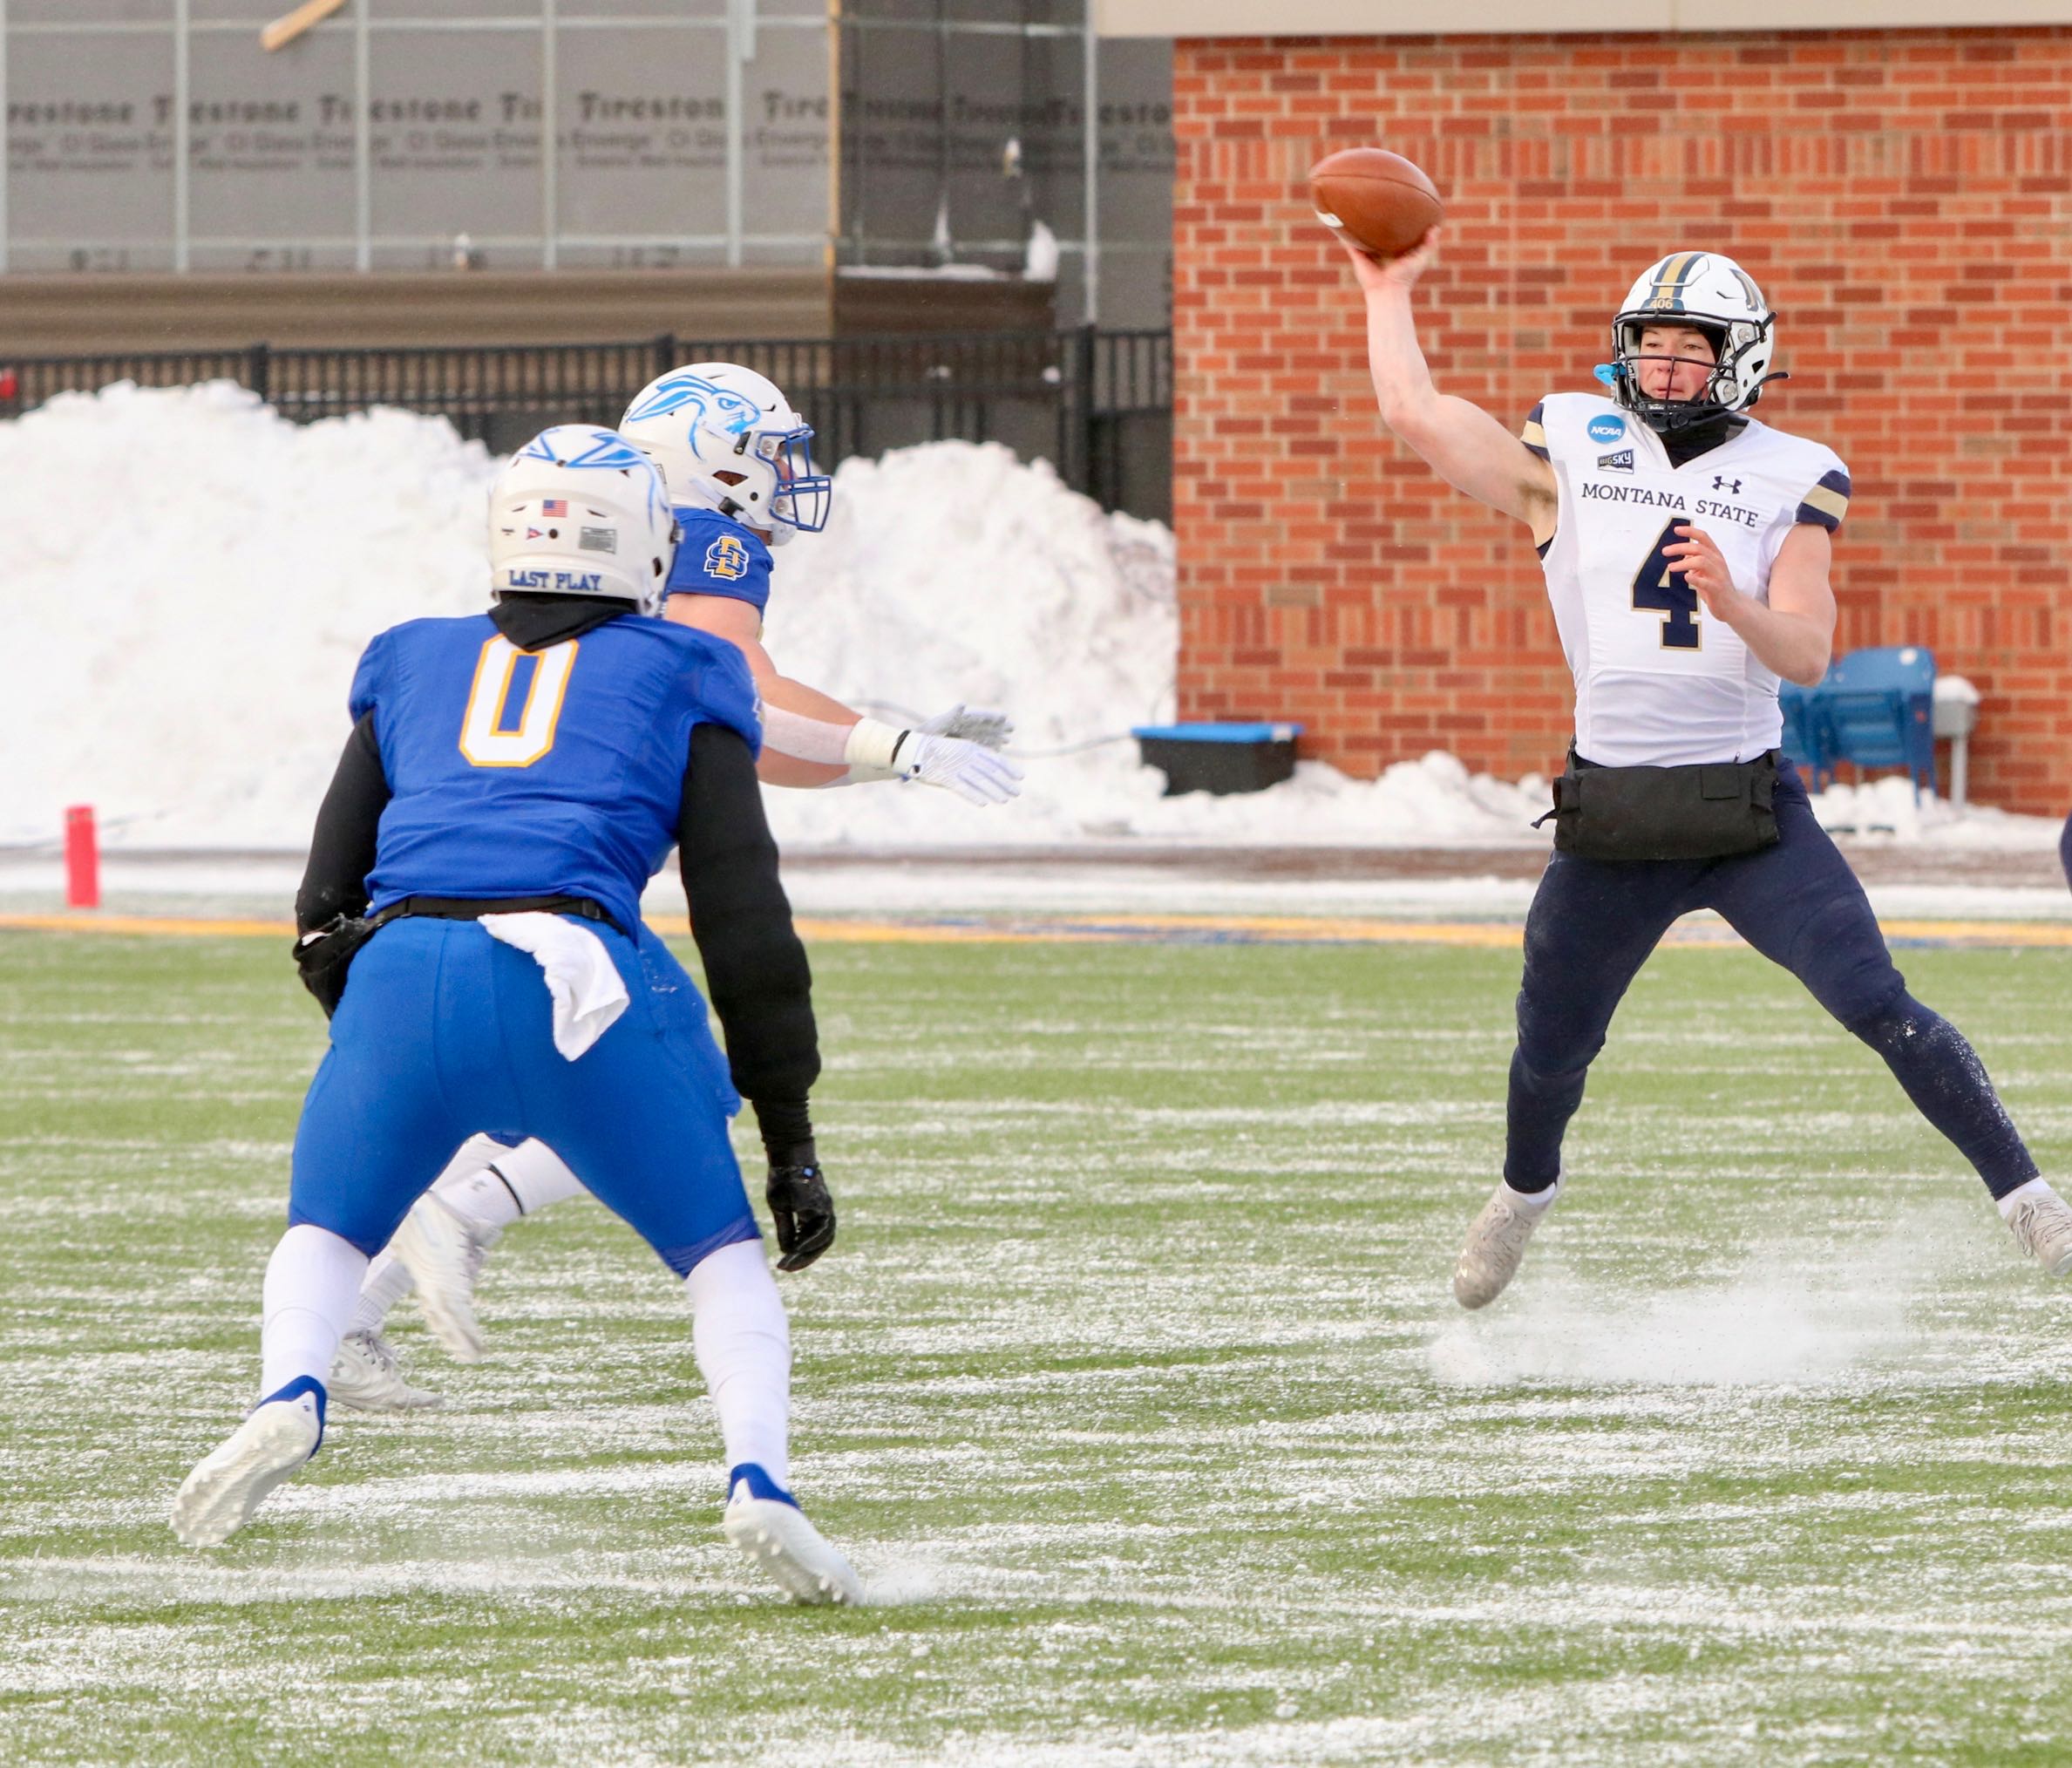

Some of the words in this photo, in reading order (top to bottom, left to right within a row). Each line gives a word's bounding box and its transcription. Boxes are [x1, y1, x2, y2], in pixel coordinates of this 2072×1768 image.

[1649, 297, 1674, 309] 406
[1591, 425, 1621, 437] NCAA
[1581, 483, 1686, 511] MONTANA
[1695, 500, 1759, 528] STATE
[508, 569, 549, 588] LAST
[555, 572, 602, 591] PLAY
[1630, 514, 1702, 651] 4
[459, 634, 579, 768] 0
